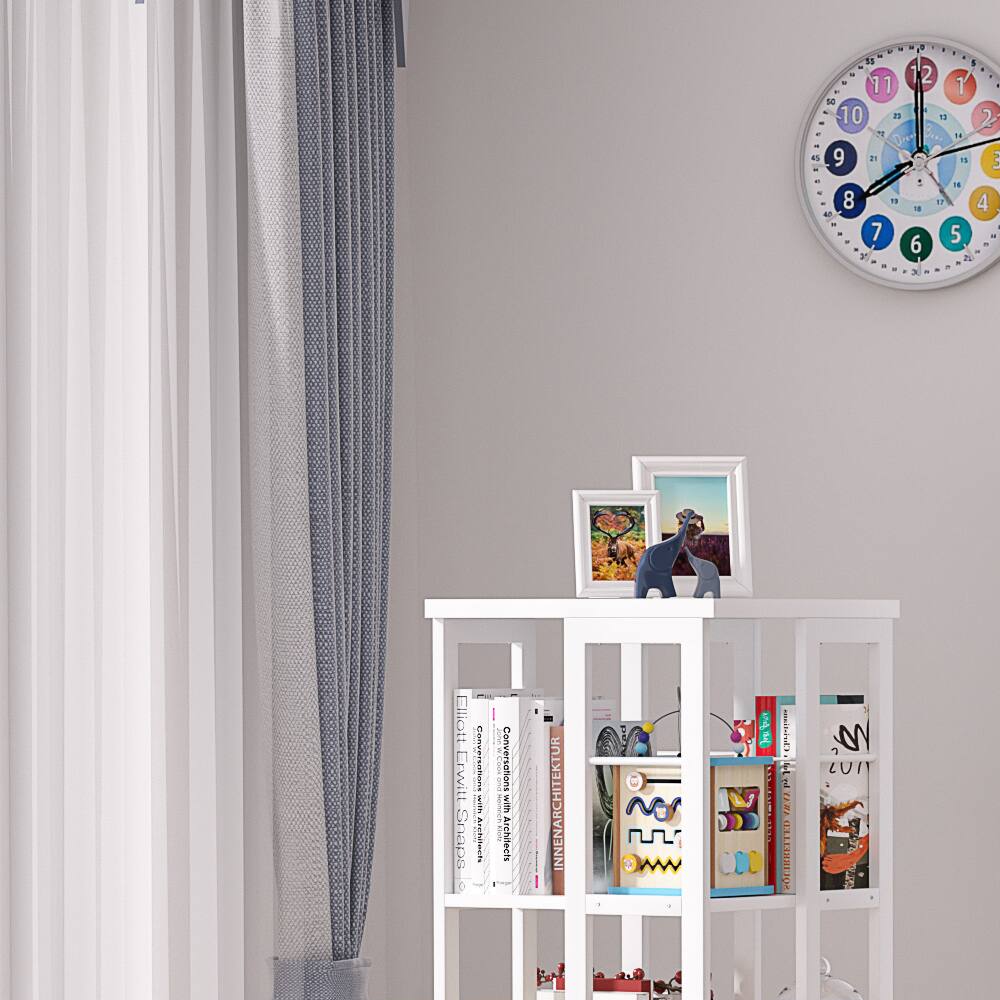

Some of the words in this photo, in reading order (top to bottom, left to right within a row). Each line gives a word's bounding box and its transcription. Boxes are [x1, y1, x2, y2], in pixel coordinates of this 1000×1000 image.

[910, 65, 932, 84] 12
[872, 75, 892, 95] 11
[956, 76, 964, 96] 1
[826, 98, 836, 106] 50
[840, 105, 863, 125] 10
[981, 108, 993, 129] 2
[833, 147, 845, 167] 9
[843, 190, 855, 210] 8
[977, 192, 989, 212] 4
[871, 222, 883, 241] 7
[950, 224, 961, 244] 5
[910, 234, 922, 254] 6
[456, 695, 468, 743] Elliott
[503, 726, 511, 792] Conversations
[456, 751, 468, 802] Erwitt
[503, 794, 511, 813] with
[551, 736, 564, 871] INNENARCHITEKTUR
[455, 809, 469, 870] Snaps
[503, 816, 511, 862] Architects
